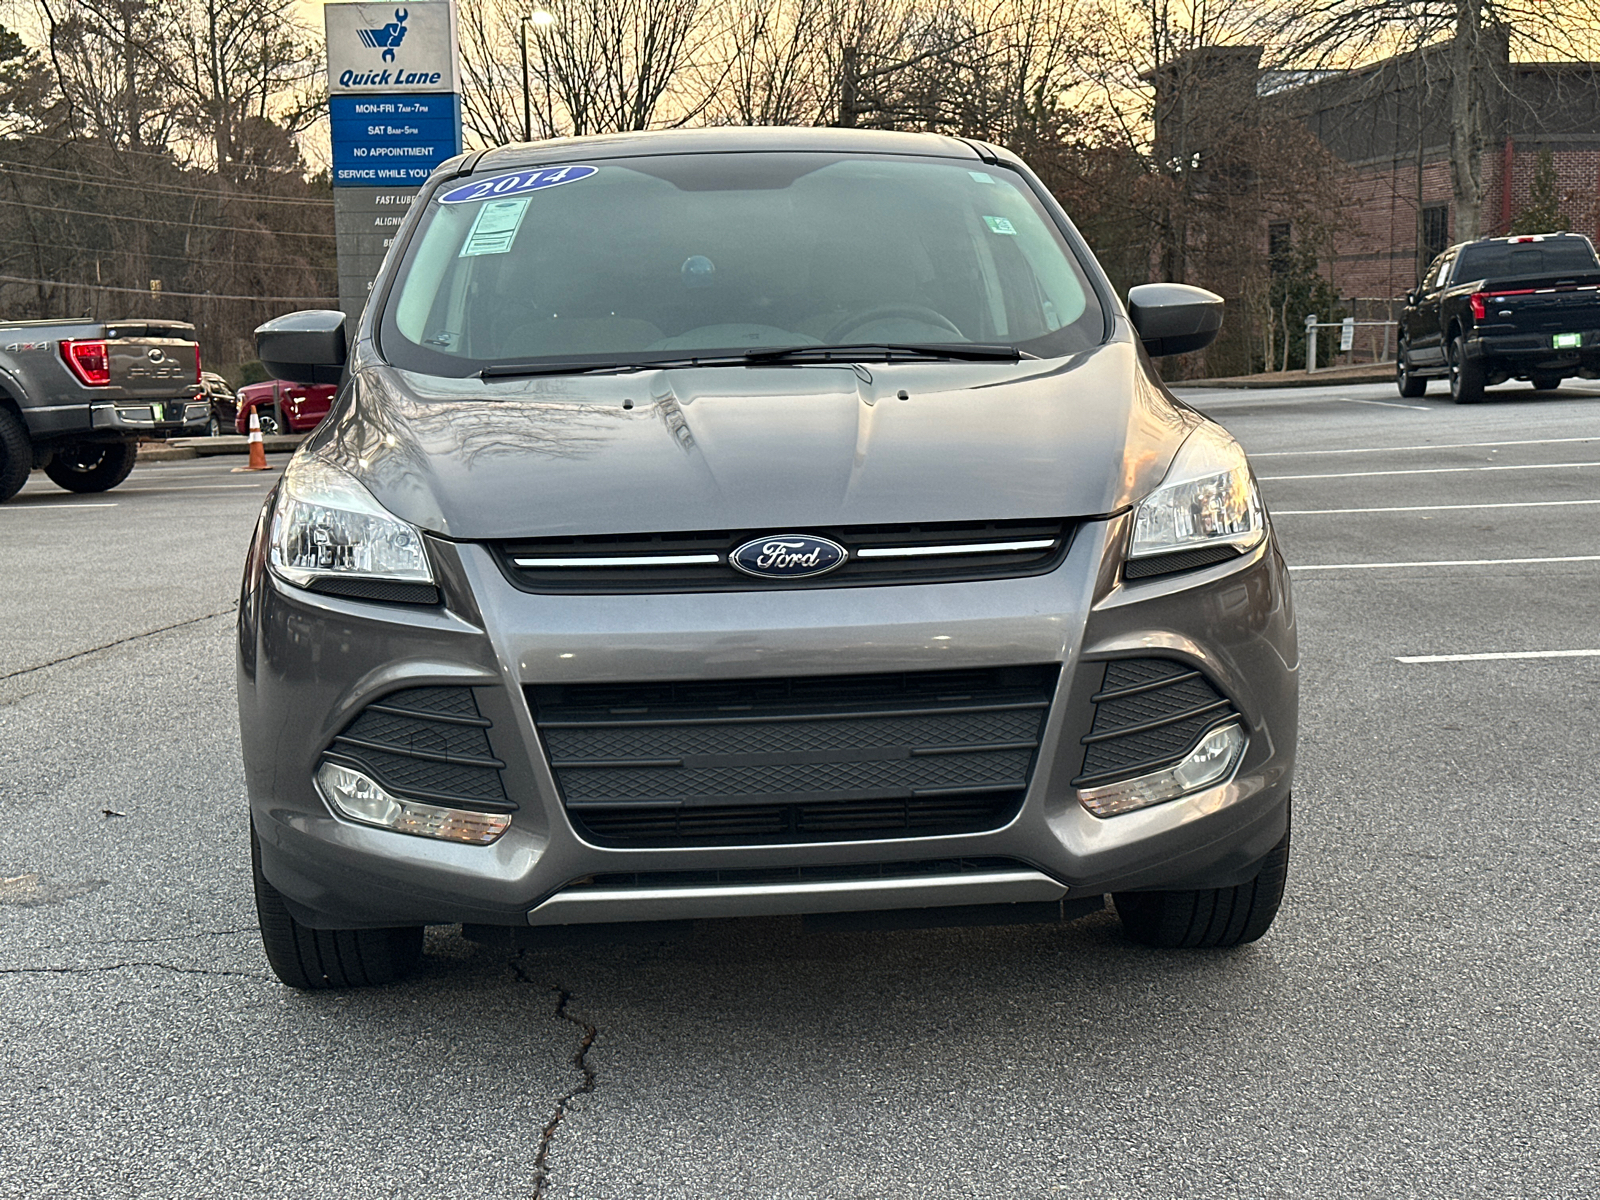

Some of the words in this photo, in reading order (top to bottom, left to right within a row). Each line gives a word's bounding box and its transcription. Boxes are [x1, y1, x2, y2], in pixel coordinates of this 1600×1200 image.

[339, 69, 392, 88] Quick
[394, 69, 441, 84] Lane
[355, 104, 395, 114] MON-FRI
[397, 103, 429, 112] 7AM-7PM
[367, 126, 385, 135] SAT
[387, 125, 418, 134] 8AM-5PM
[353, 147, 368, 157] NO
[369, 147, 434, 157] APPOINTMENT
[338, 169, 376, 179] SERVICE
[377, 169, 407, 178] WHILE
[409, 168, 428, 178] YOU
[466, 167, 572, 200] 2014
[375, 195, 395, 205] FAST
[756, 541, 821, 569] Ford
